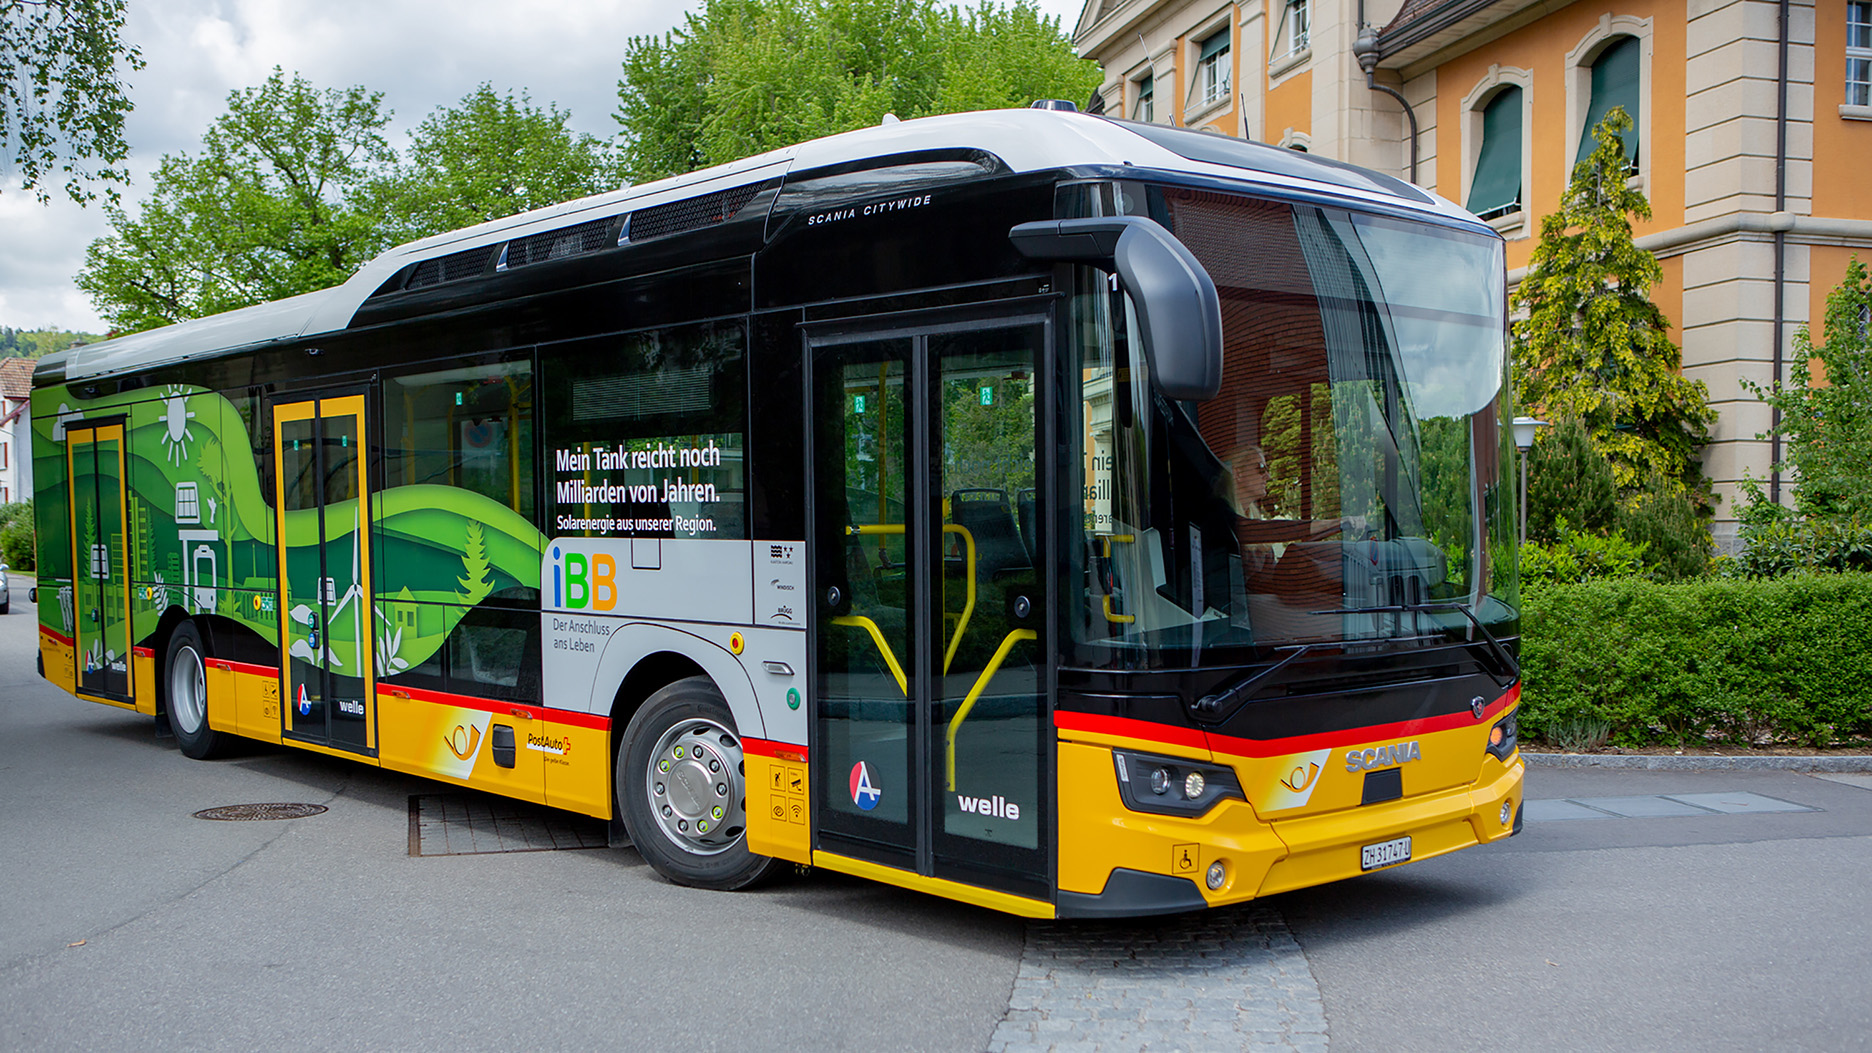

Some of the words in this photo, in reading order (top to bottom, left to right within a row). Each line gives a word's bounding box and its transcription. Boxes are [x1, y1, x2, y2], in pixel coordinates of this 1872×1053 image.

[808, 208, 855, 226] SCANIA
[863, 195, 932, 216] CITYWIDE
[556, 446, 591, 472] Mein
[592, 444, 629, 471] Tank
[631, 442, 676, 469] reicht
[679, 439, 721, 468] noch
[556, 478, 626, 504] Milliarden
[629, 483, 658, 504] von
[660, 476, 721, 504] Jahren.
[556, 514, 616, 535] Solarenergie
[616, 517, 634, 531] aus
[635, 517, 674, 532] unserer
[675, 514, 717, 536] Region.
[553, 546, 618, 612] iBB
[553, 618, 568, 631] Der
[569, 619, 610, 636] Anschluss
[553, 638, 568, 651] ans
[569, 637, 595, 653] Leben
[339, 699, 365, 715] welle
[528, 733, 563, 751] PostAuto
[1345, 741, 1422, 773] SCANIA
[957, 795, 1020, 820] welle
